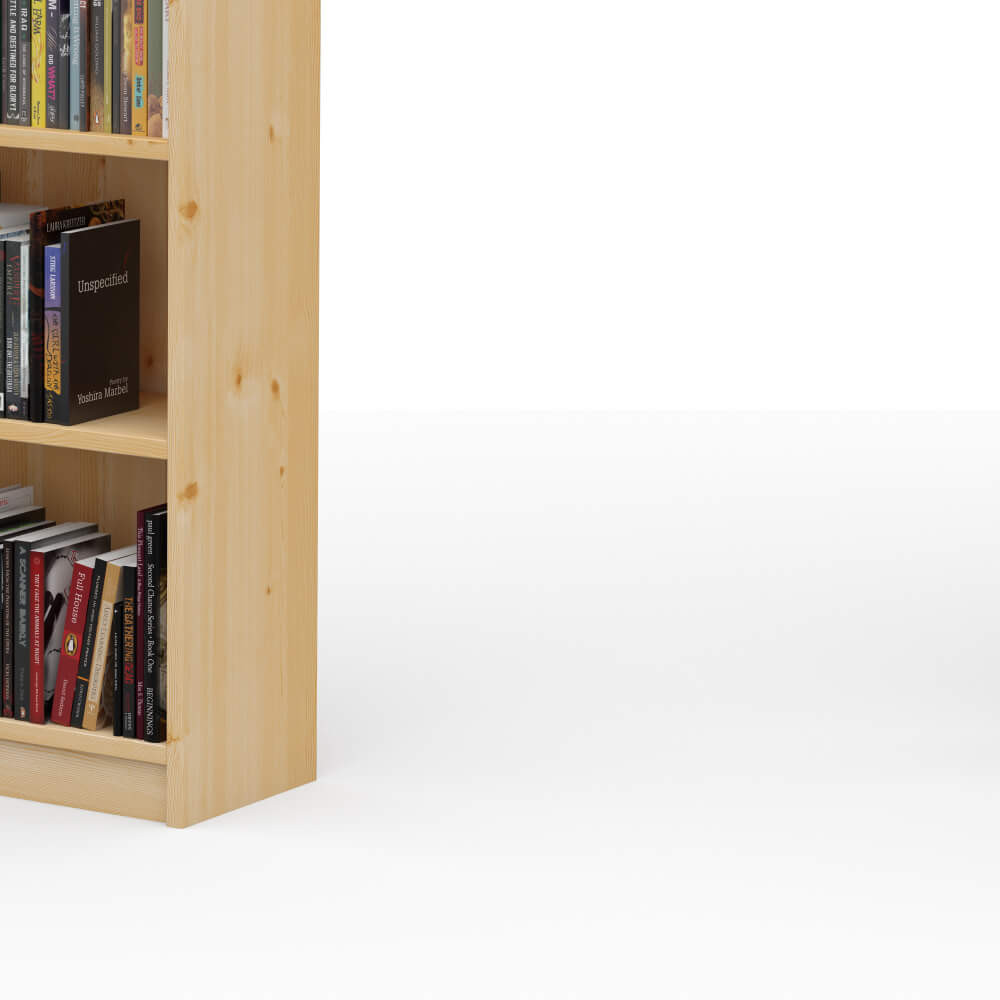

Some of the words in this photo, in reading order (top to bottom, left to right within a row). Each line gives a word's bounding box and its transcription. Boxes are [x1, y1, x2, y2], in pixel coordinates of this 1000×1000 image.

[9, 20, 17, 33] AND
[33, 9, 43, 34] FARM
[9, 36, 17, 67] DESTINED
[9, 70, 17, 82] FOR
[48, 66, 56, 100] WHAT?
[9, 85, 17, 110] GLORY!
[78, 272, 128, 293] Unspecified
[78, 391, 102, 405] Yoshira
[105, 384, 128, 398] Marbel
[146, 521, 154, 533] paul
[146, 535, 154, 554] green
[77, 572, 86, 591] Full
[146, 563, 154, 588] Second
[71, 595, 83, 623] House
[146, 590, 154, 614] Chance
[146, 616, 154, 634] Series
[146, 640, 154, 656] Book
[146, 658, 154, 672] One
[146, 687, 154, 735] BEGINNINGS
